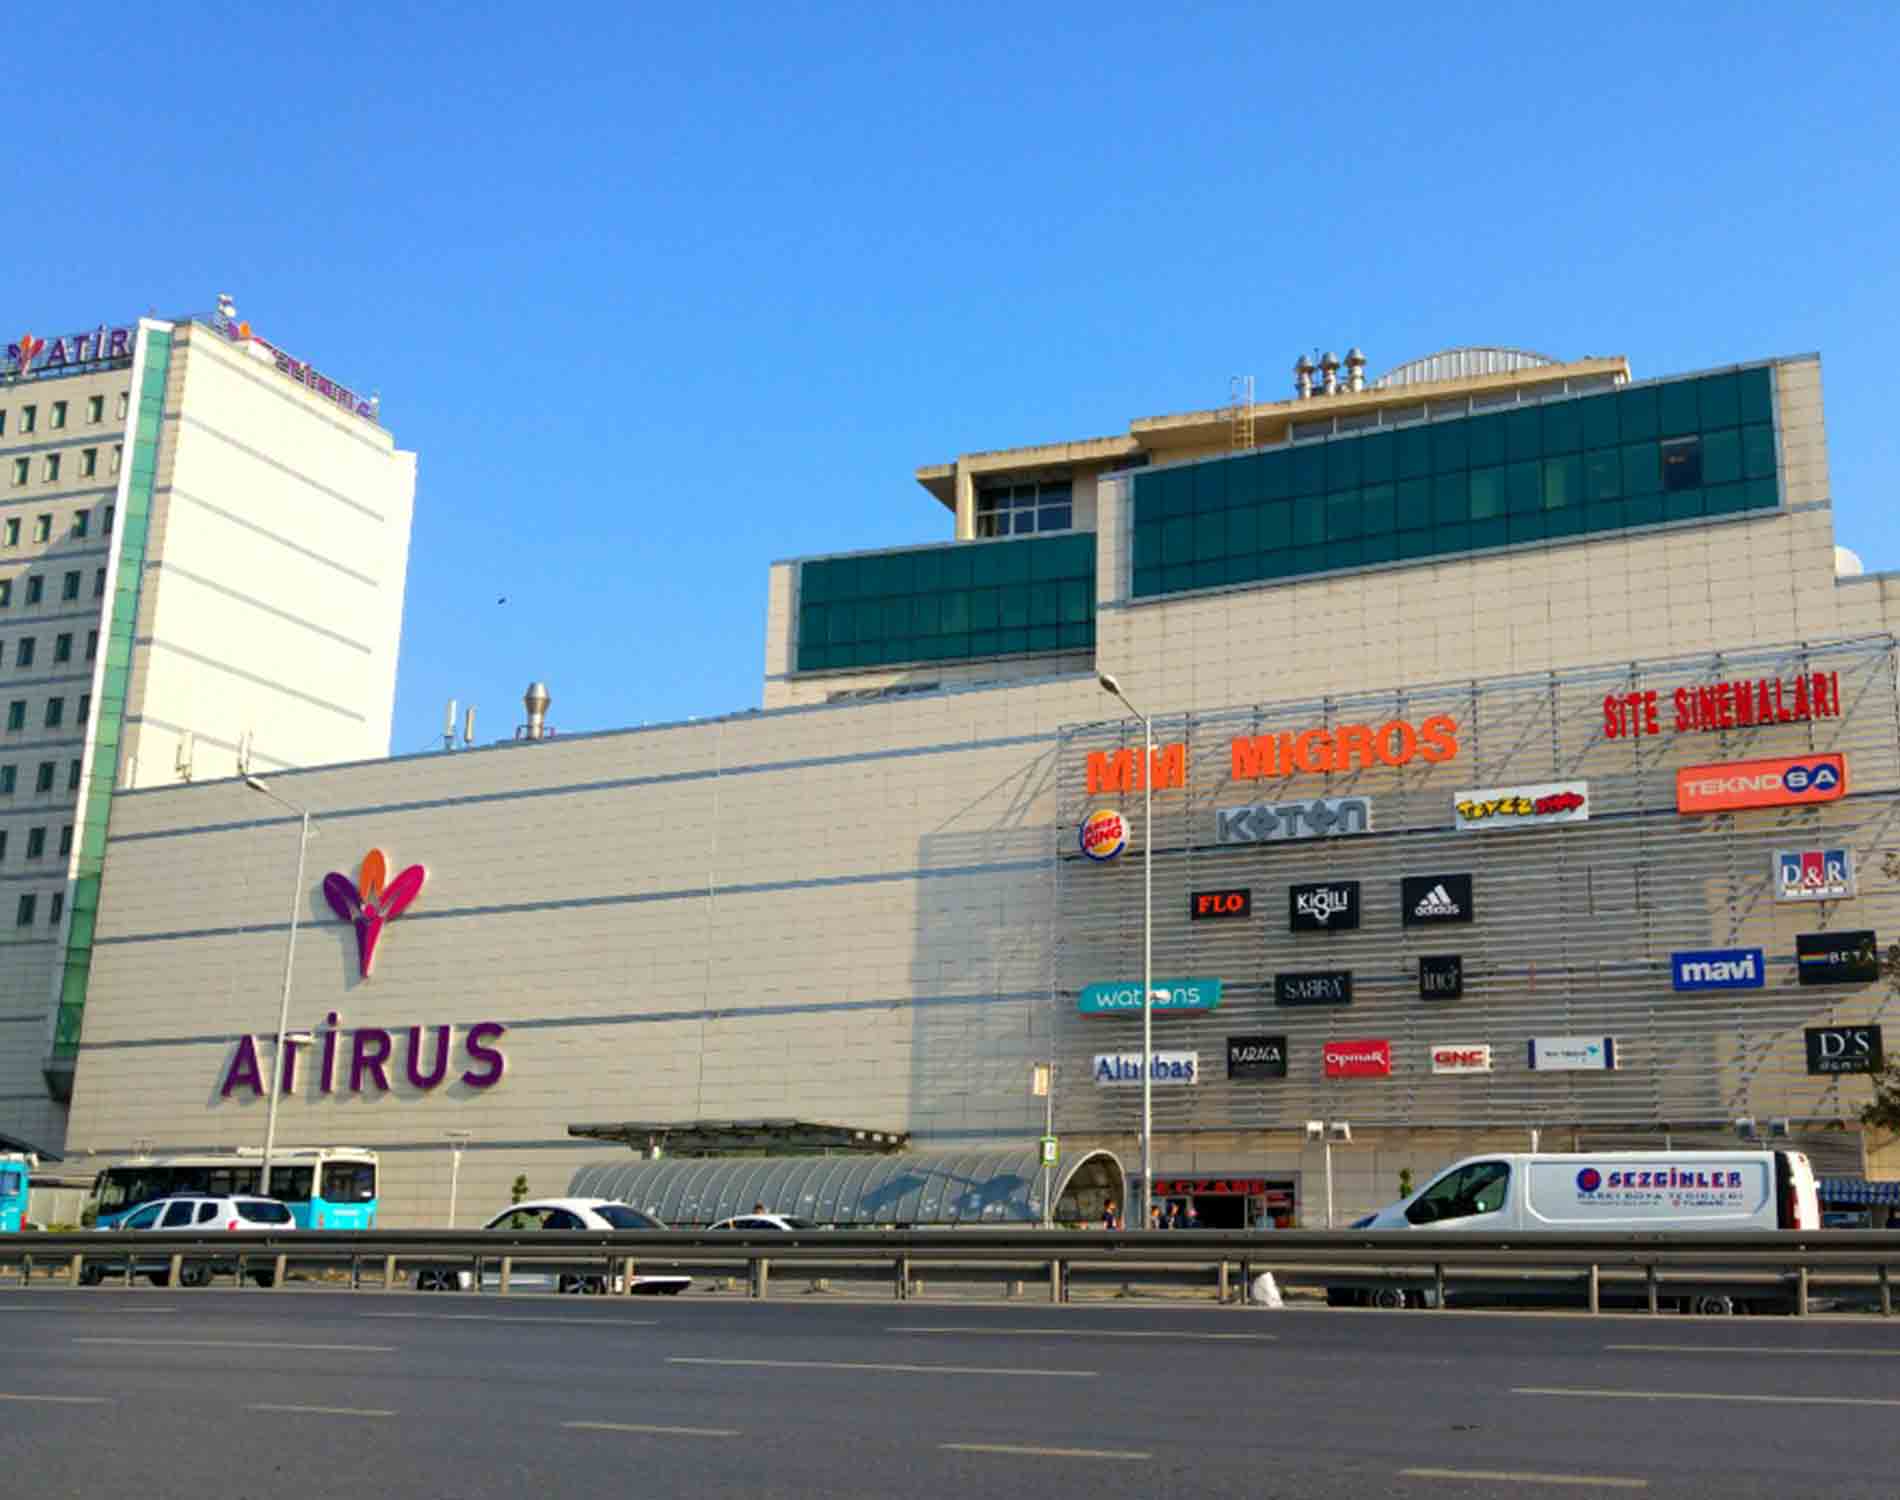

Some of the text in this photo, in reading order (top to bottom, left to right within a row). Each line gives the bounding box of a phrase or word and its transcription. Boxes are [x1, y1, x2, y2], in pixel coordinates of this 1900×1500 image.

[1682, 767, 1837, 798] TEKNOSA
[1782, 861, 1846, 886] D&R
[1197, 894, 1245, 913] FLO
[1415, 902, 1460, 917] adidas
[1681, 954, 1756, 982] mavi
[1095, 986, 1201, 1007] watons
[220, 1010, 506, 1097] ATİRUS
[1819, 1030, 1871, 1057] D'S
[1433, 1051, 1484, 1066] GNC
[1607, 1166, 1742, 1188] SEZGİNLER
